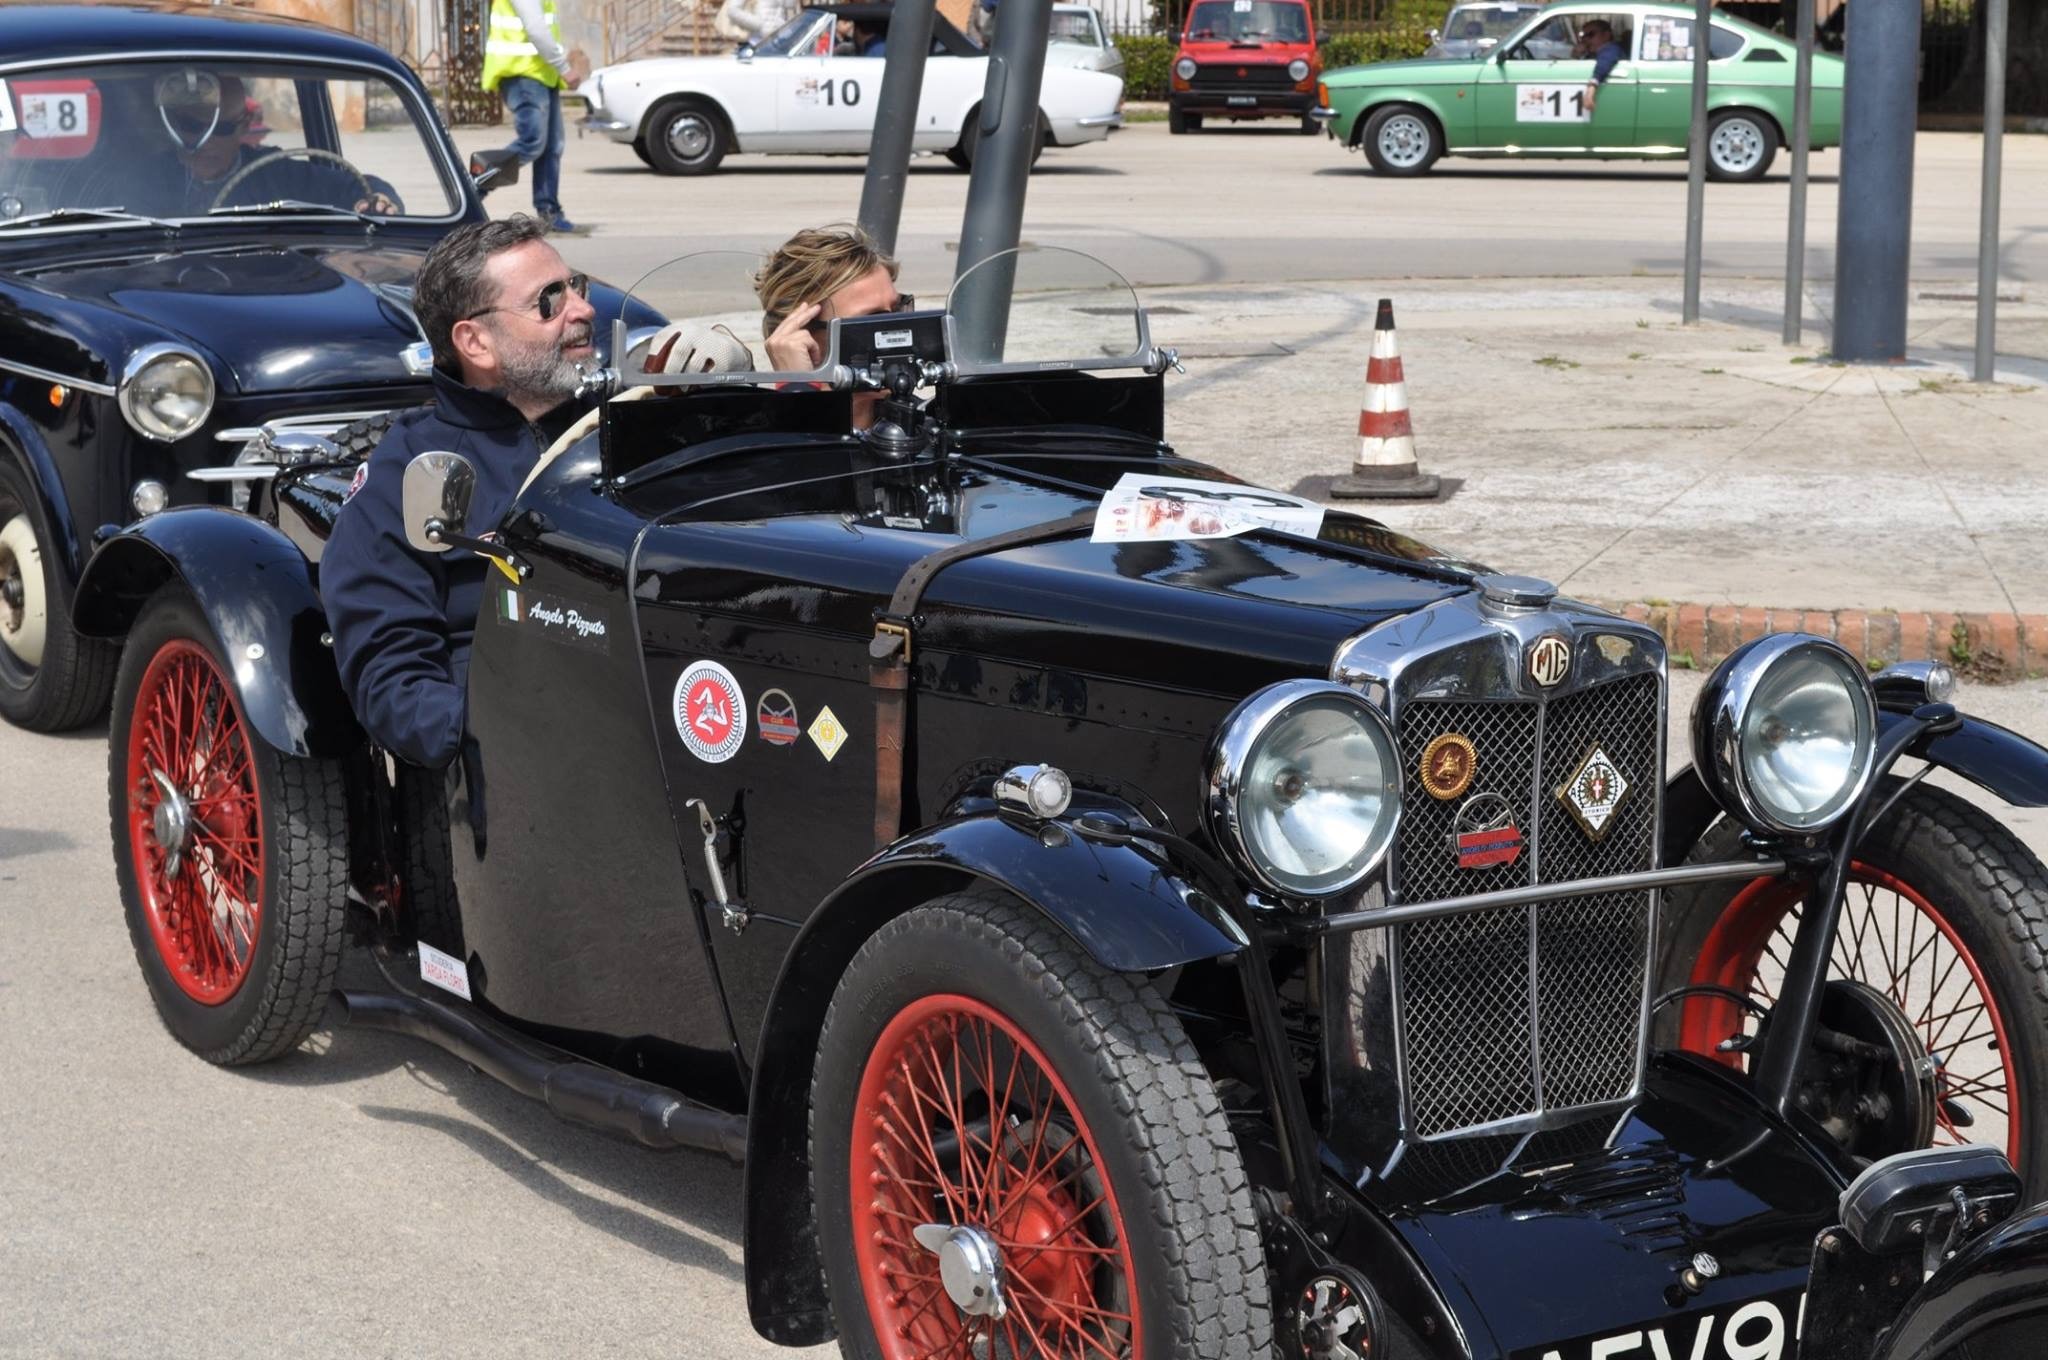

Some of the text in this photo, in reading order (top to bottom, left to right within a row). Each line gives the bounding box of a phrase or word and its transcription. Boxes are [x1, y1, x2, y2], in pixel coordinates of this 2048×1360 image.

[820, 79, 861, 106] 10
[1547, 90, 1584, 117] 11
[58, 100, 77, 131] 8
[529, 601, 606, 637] Angelo Pizzuto
[1535, 641, 1568, 682] MG
